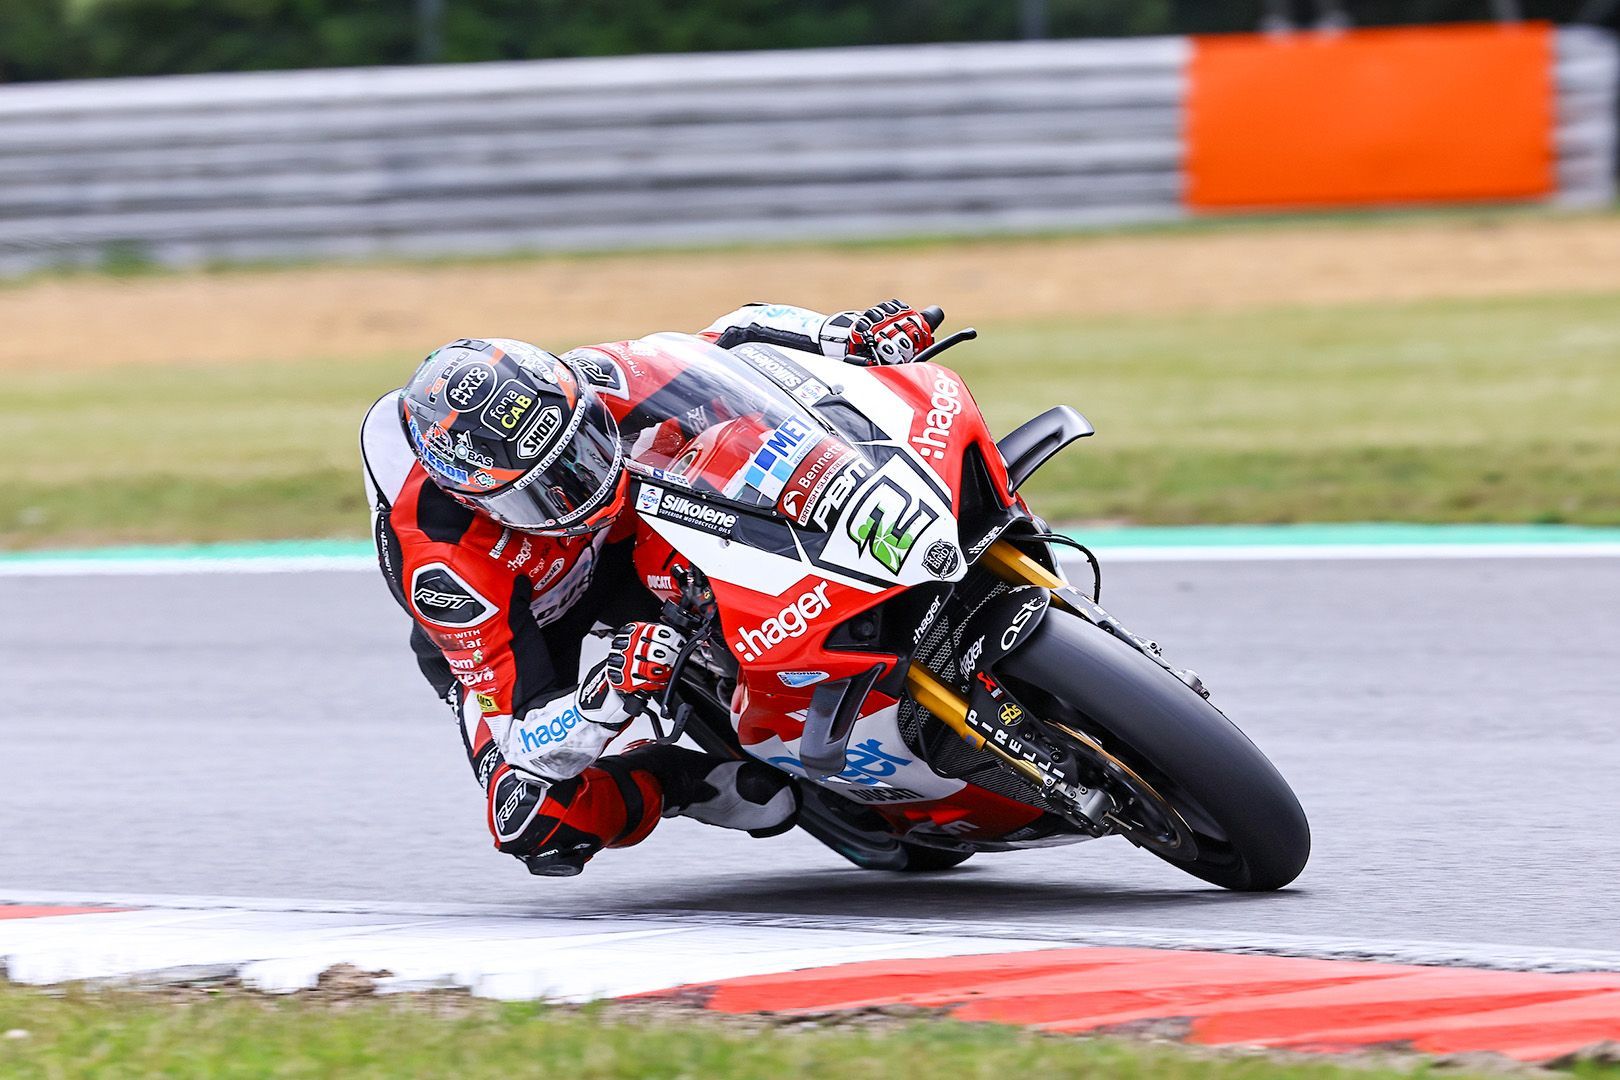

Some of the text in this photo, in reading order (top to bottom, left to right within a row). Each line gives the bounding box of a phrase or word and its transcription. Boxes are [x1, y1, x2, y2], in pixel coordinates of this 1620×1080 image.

[449, 366, 482, 401] MOTO
[459, 370, 489, 406] HALO
[501, 394, 532, 429] CAB
[518, 403, 586, 488] ducatistore.co.uk
[523, 411, 558, 453] SHOEI
[766, 414, 812, 458] MET
[468, 451, 494, 468] BAS
[658, 508, 732, 536] SUPERIOR MOTORCYCLE OILS
[661, 494, 737, 529] Silkolene
[845, 474, 940, 577] 2
[921, 538, 946, 567] FRANK
[931, 548, 950, 570] BIRD
[414, 587, 476, 610] RST
[454, 628, 481, 639] WITH
[967, 708, 1066, 779] PIRELLI
[496, 780, 528, 832] RST
